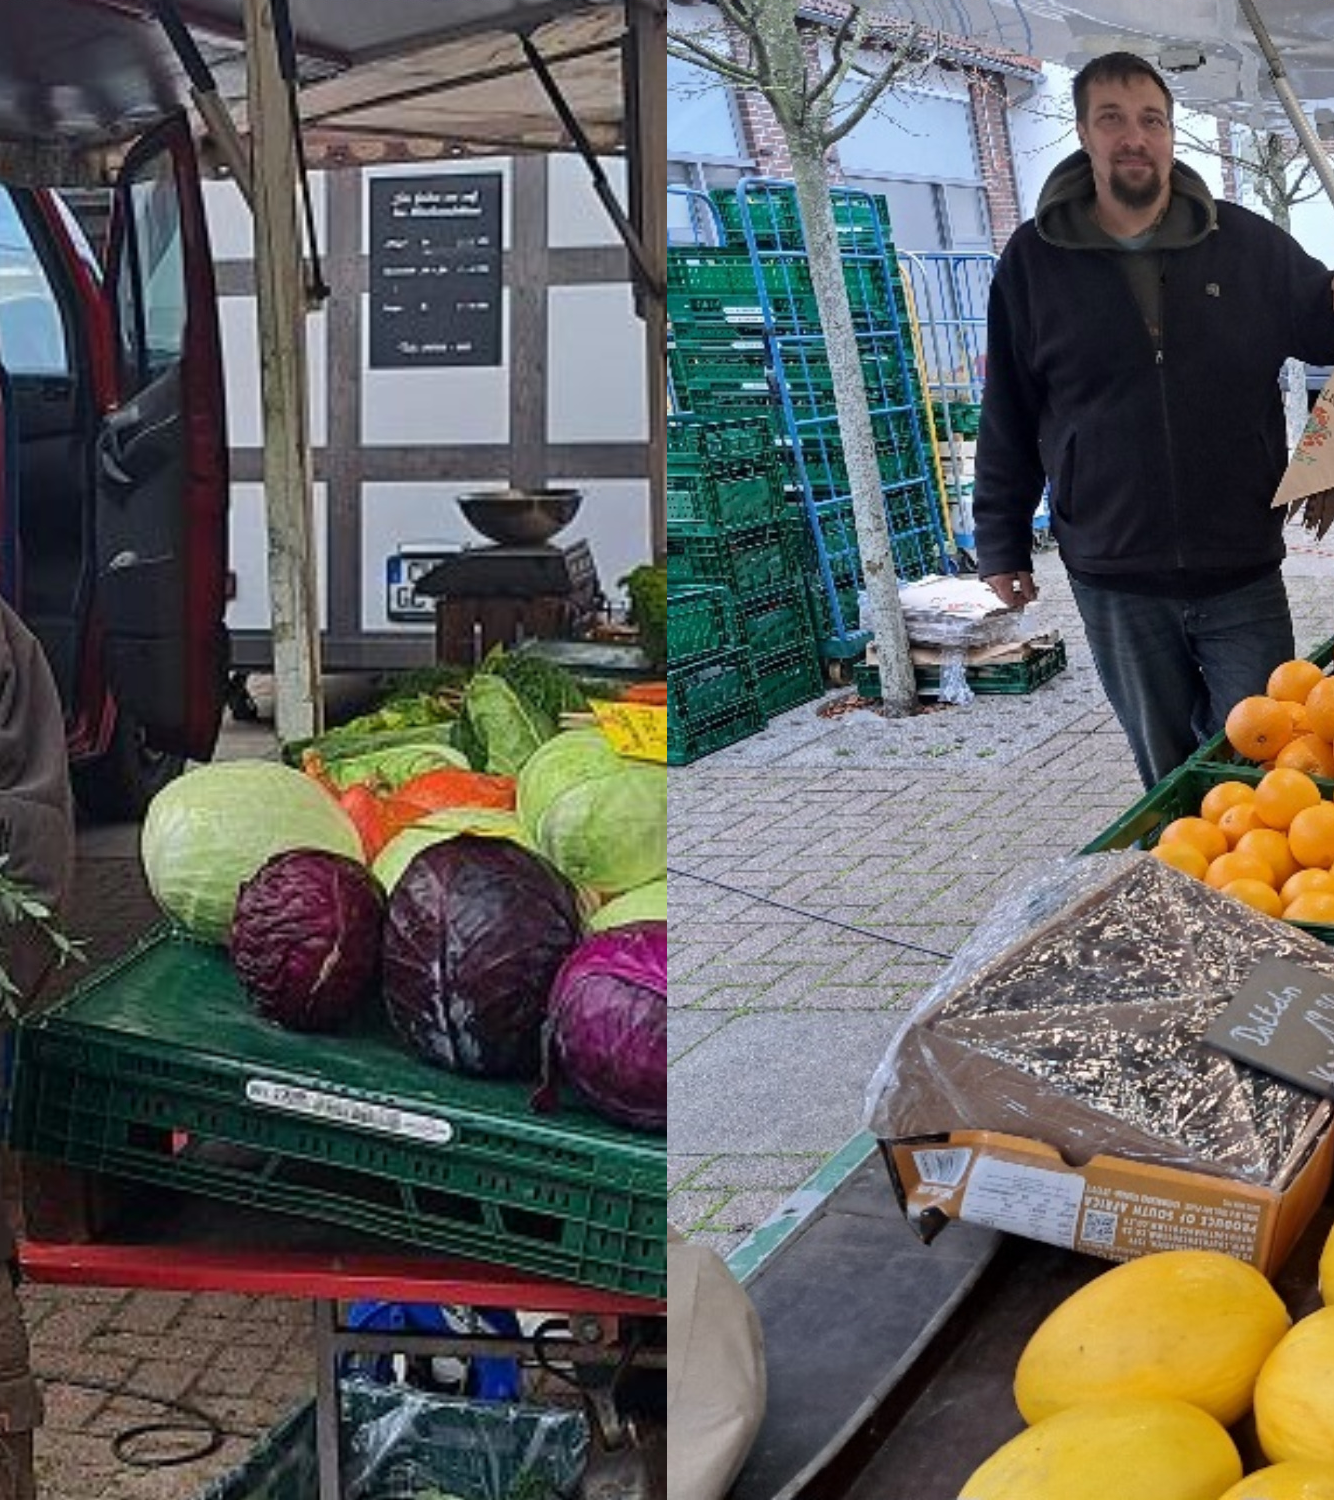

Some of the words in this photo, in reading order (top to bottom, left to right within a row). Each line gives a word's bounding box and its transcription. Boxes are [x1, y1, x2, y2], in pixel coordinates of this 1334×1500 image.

[1084, 1195, 1129, 1213] AFRICA
[1132, 1204, 1175, 1221] SOUTH
[1179, 1210, 1196, 1223] OF
[1200, 1217, 1258, 1234] PRODUCE
